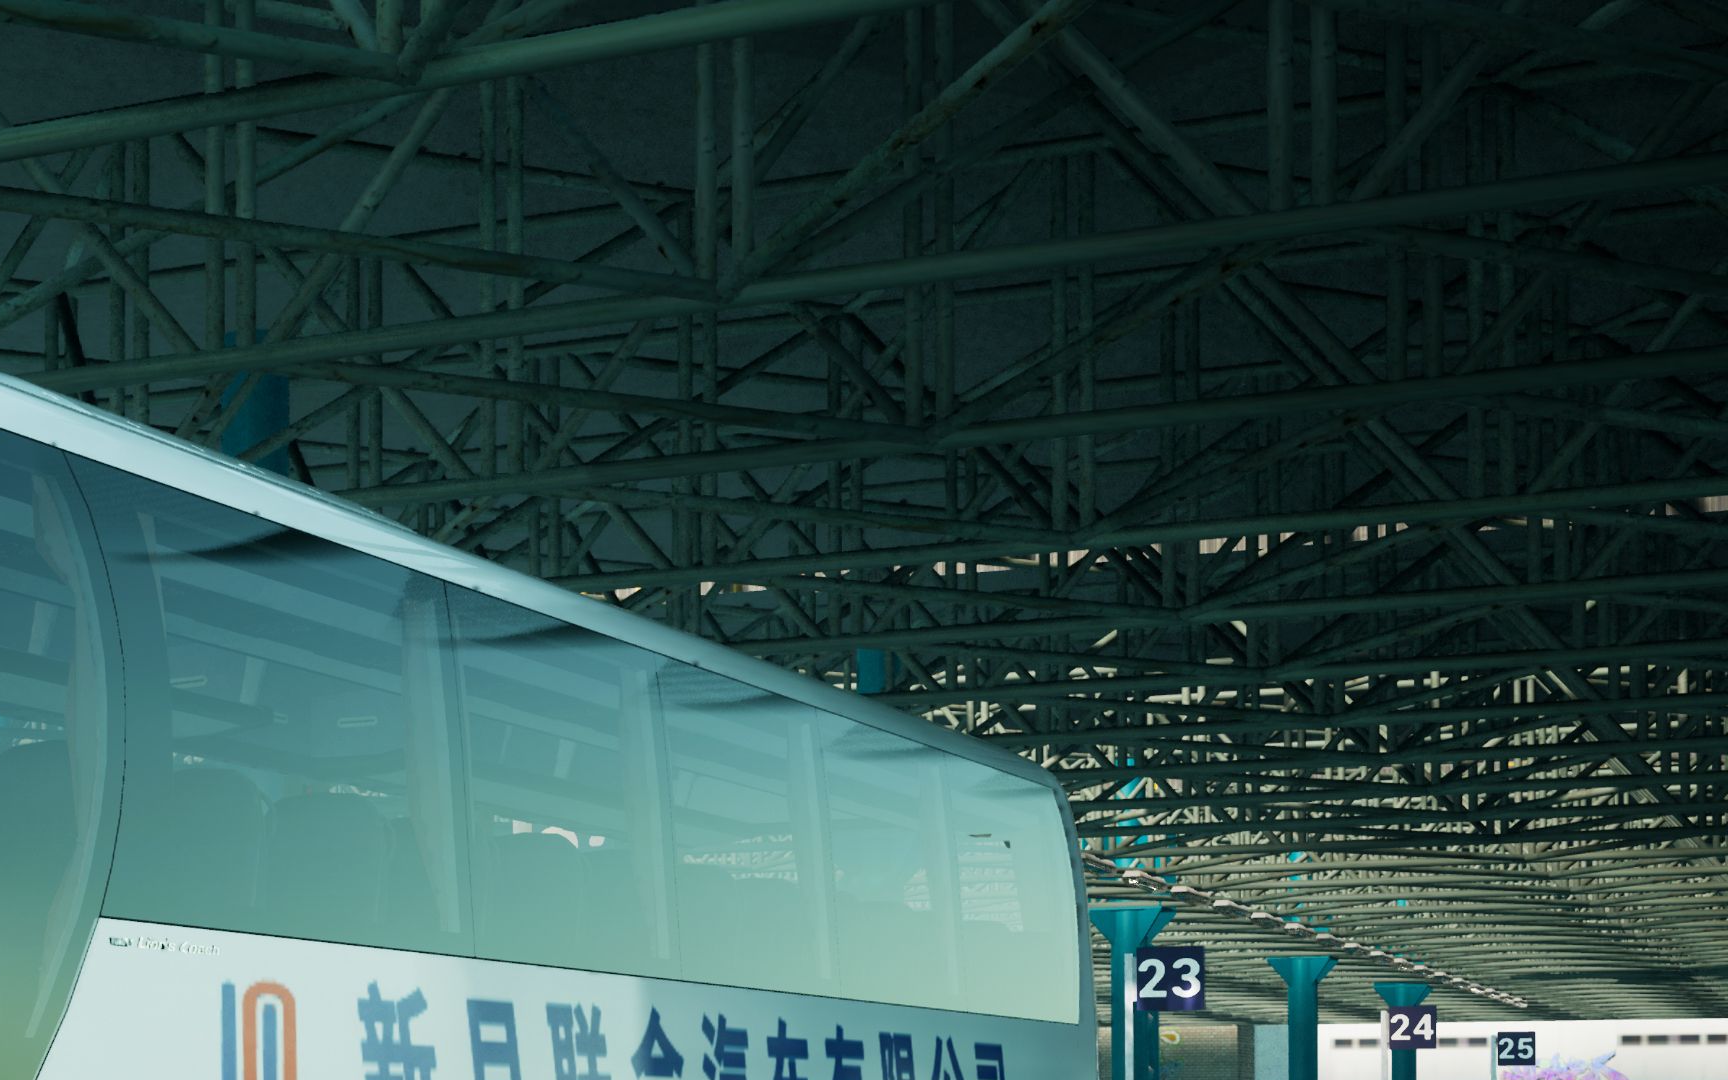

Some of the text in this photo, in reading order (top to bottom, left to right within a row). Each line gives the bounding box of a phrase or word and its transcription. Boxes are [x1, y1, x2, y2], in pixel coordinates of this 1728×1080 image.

[1138, 958, 1202, 999] 23
[1390, 1013, 1434, 1041] 24
[1498, 1037, 1535, 1060] 25
